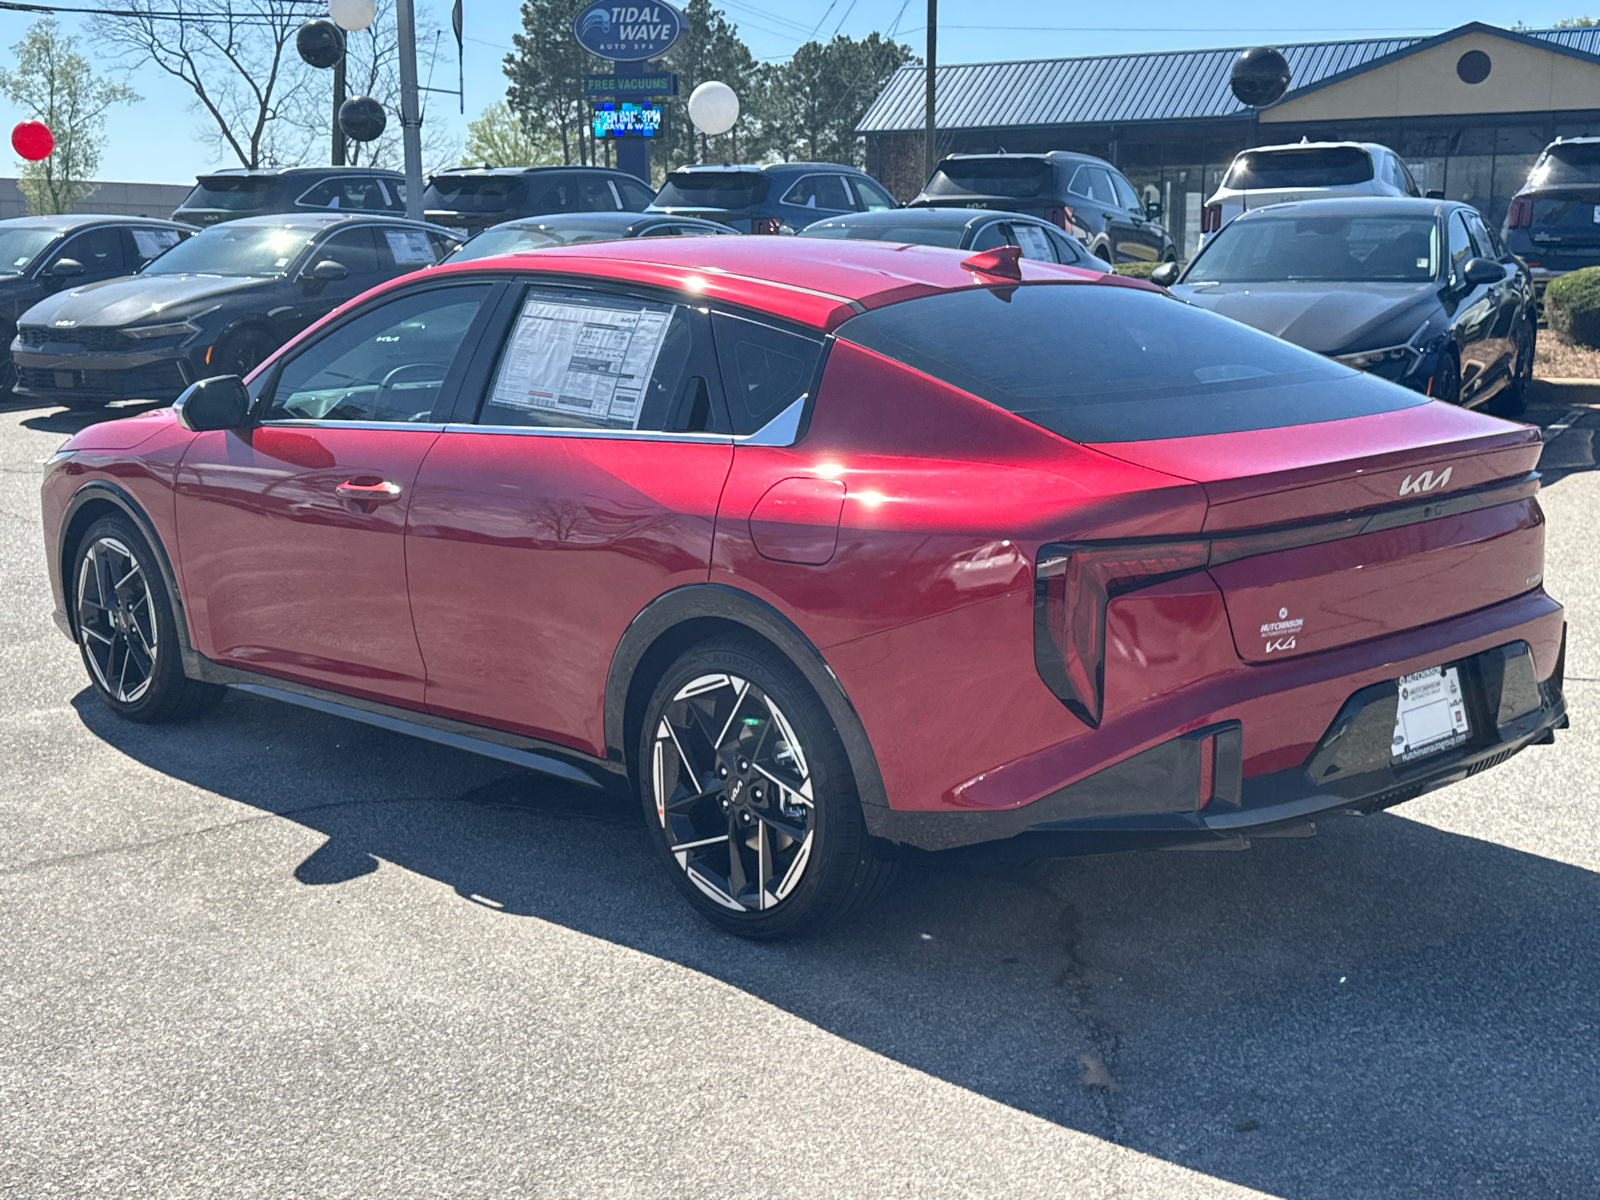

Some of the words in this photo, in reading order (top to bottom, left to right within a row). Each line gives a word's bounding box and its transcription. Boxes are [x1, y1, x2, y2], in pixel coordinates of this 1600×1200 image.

[611, 7, 661, 23] TIDAL
[619, 24, 671, 41] WAVE
[588, 80, 615, 90] FREE
[617, 78, 667, 90] VACUUMS
[1399, 466, 1453, 496] KIA
[1260, 618, 1304, 633] HUTCHINSON
[1265, 635, 1297, 654] K4
[713, 652, 765, 678] KUMHO
